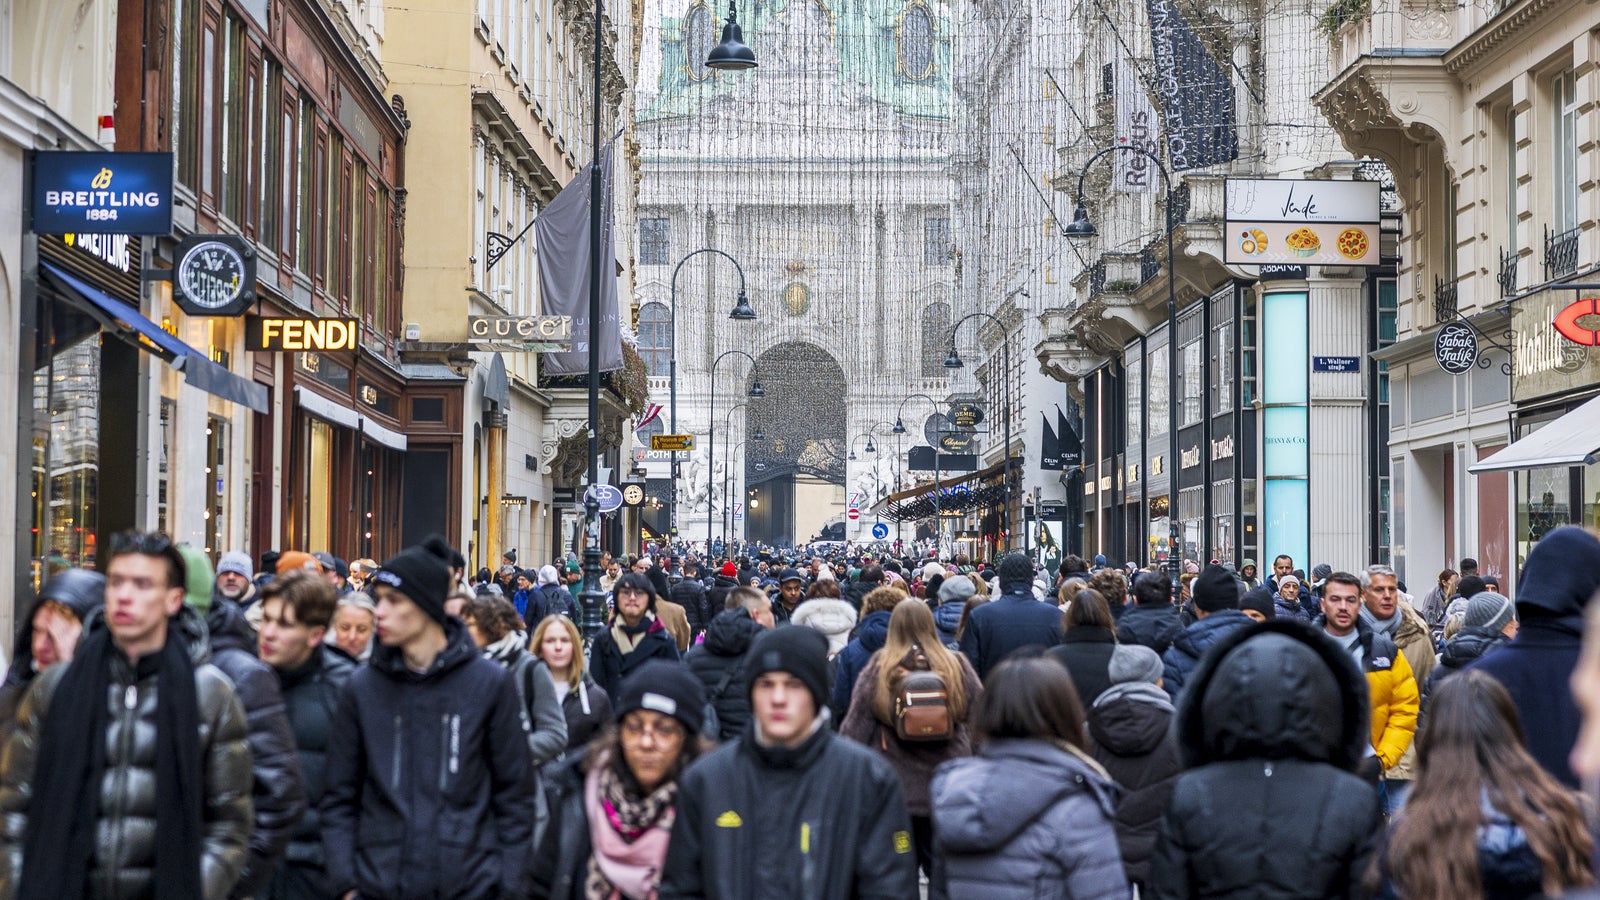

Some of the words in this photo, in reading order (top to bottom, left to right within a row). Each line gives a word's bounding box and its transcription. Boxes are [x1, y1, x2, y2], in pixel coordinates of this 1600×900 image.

[1125, 110, 1158, 188] Regus
[46, 191, 160, 207] BREITLING
[86, 209, 118, 221] 1884
[262, 319, 356, 350] FENDI
[472, 319, 566, 336] GUCCI
[1438, 334, 1475, 348] Tabak
[1438, 347, 1475, 365] Trafik
[942, 437, 970, 448] Chopard
